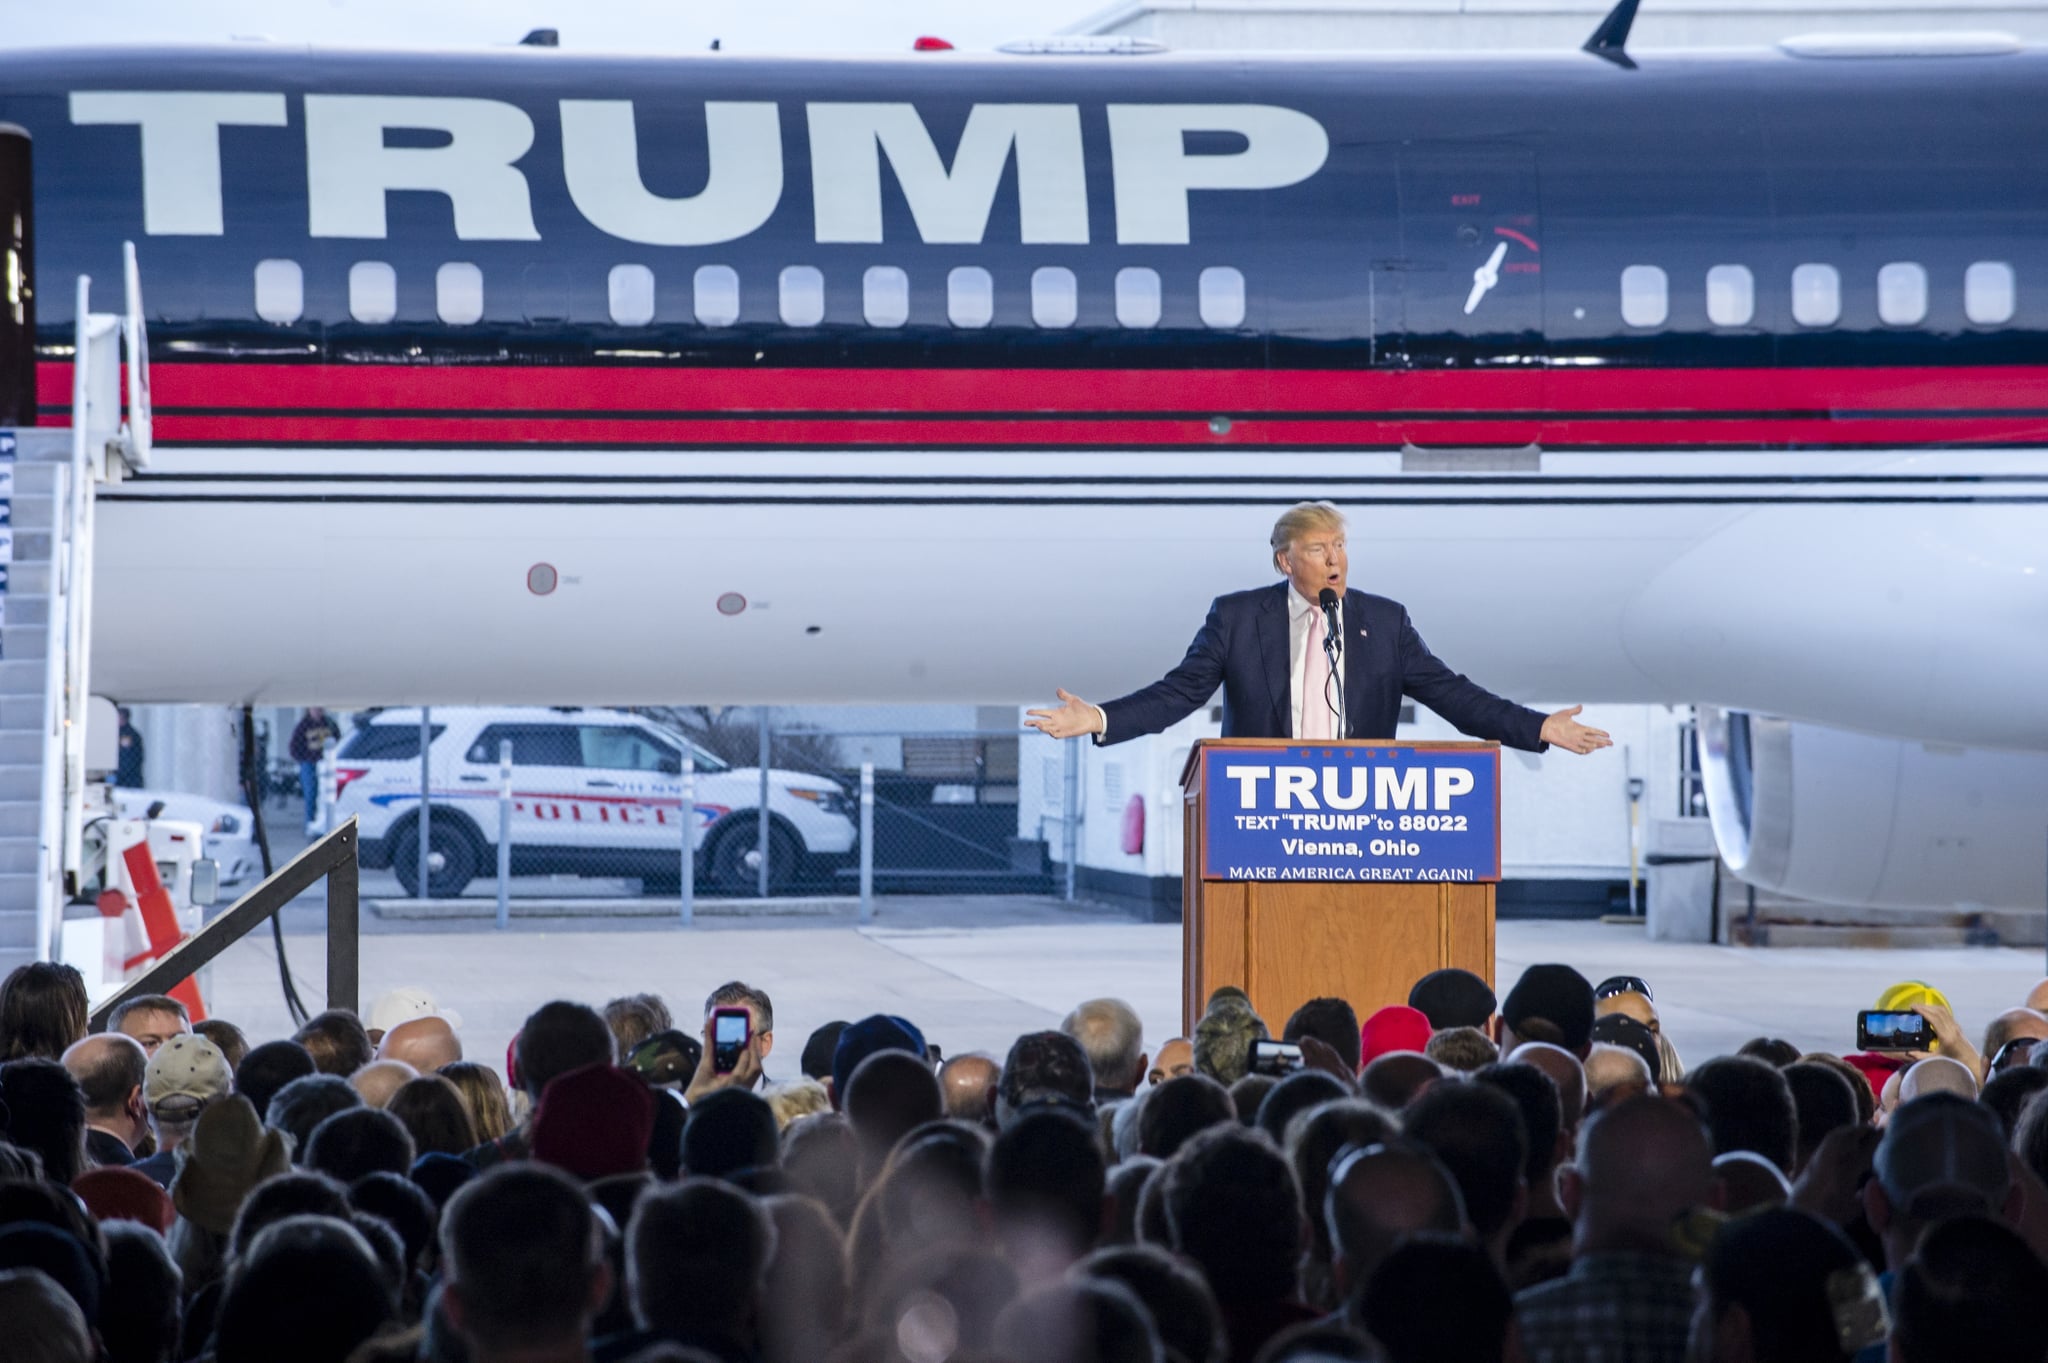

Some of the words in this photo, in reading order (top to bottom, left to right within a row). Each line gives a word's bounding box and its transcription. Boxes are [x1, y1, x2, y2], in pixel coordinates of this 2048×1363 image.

[69, 91, 1329, 247] TRUMP
[1226, 765, 1475, 811] TRUMP
[1234, 815, 1280, 830] TEXT
[1282, 813, 1377, 831] "TRUMP"
[1377, 817, 1394, 831] to
[1399, 815, 1468, 832] 88022
[1281, 838, 1363, 858] Vienna,
[1369, 838, 1421, 857] Ohio
[1229, 866, 1277, 879] MAKE
[1281, 866, 1356, 880] AMERICA
[1359, 867, 1413, 880] GREAT
[1417, 868, 1474, 881] AGAIN!
